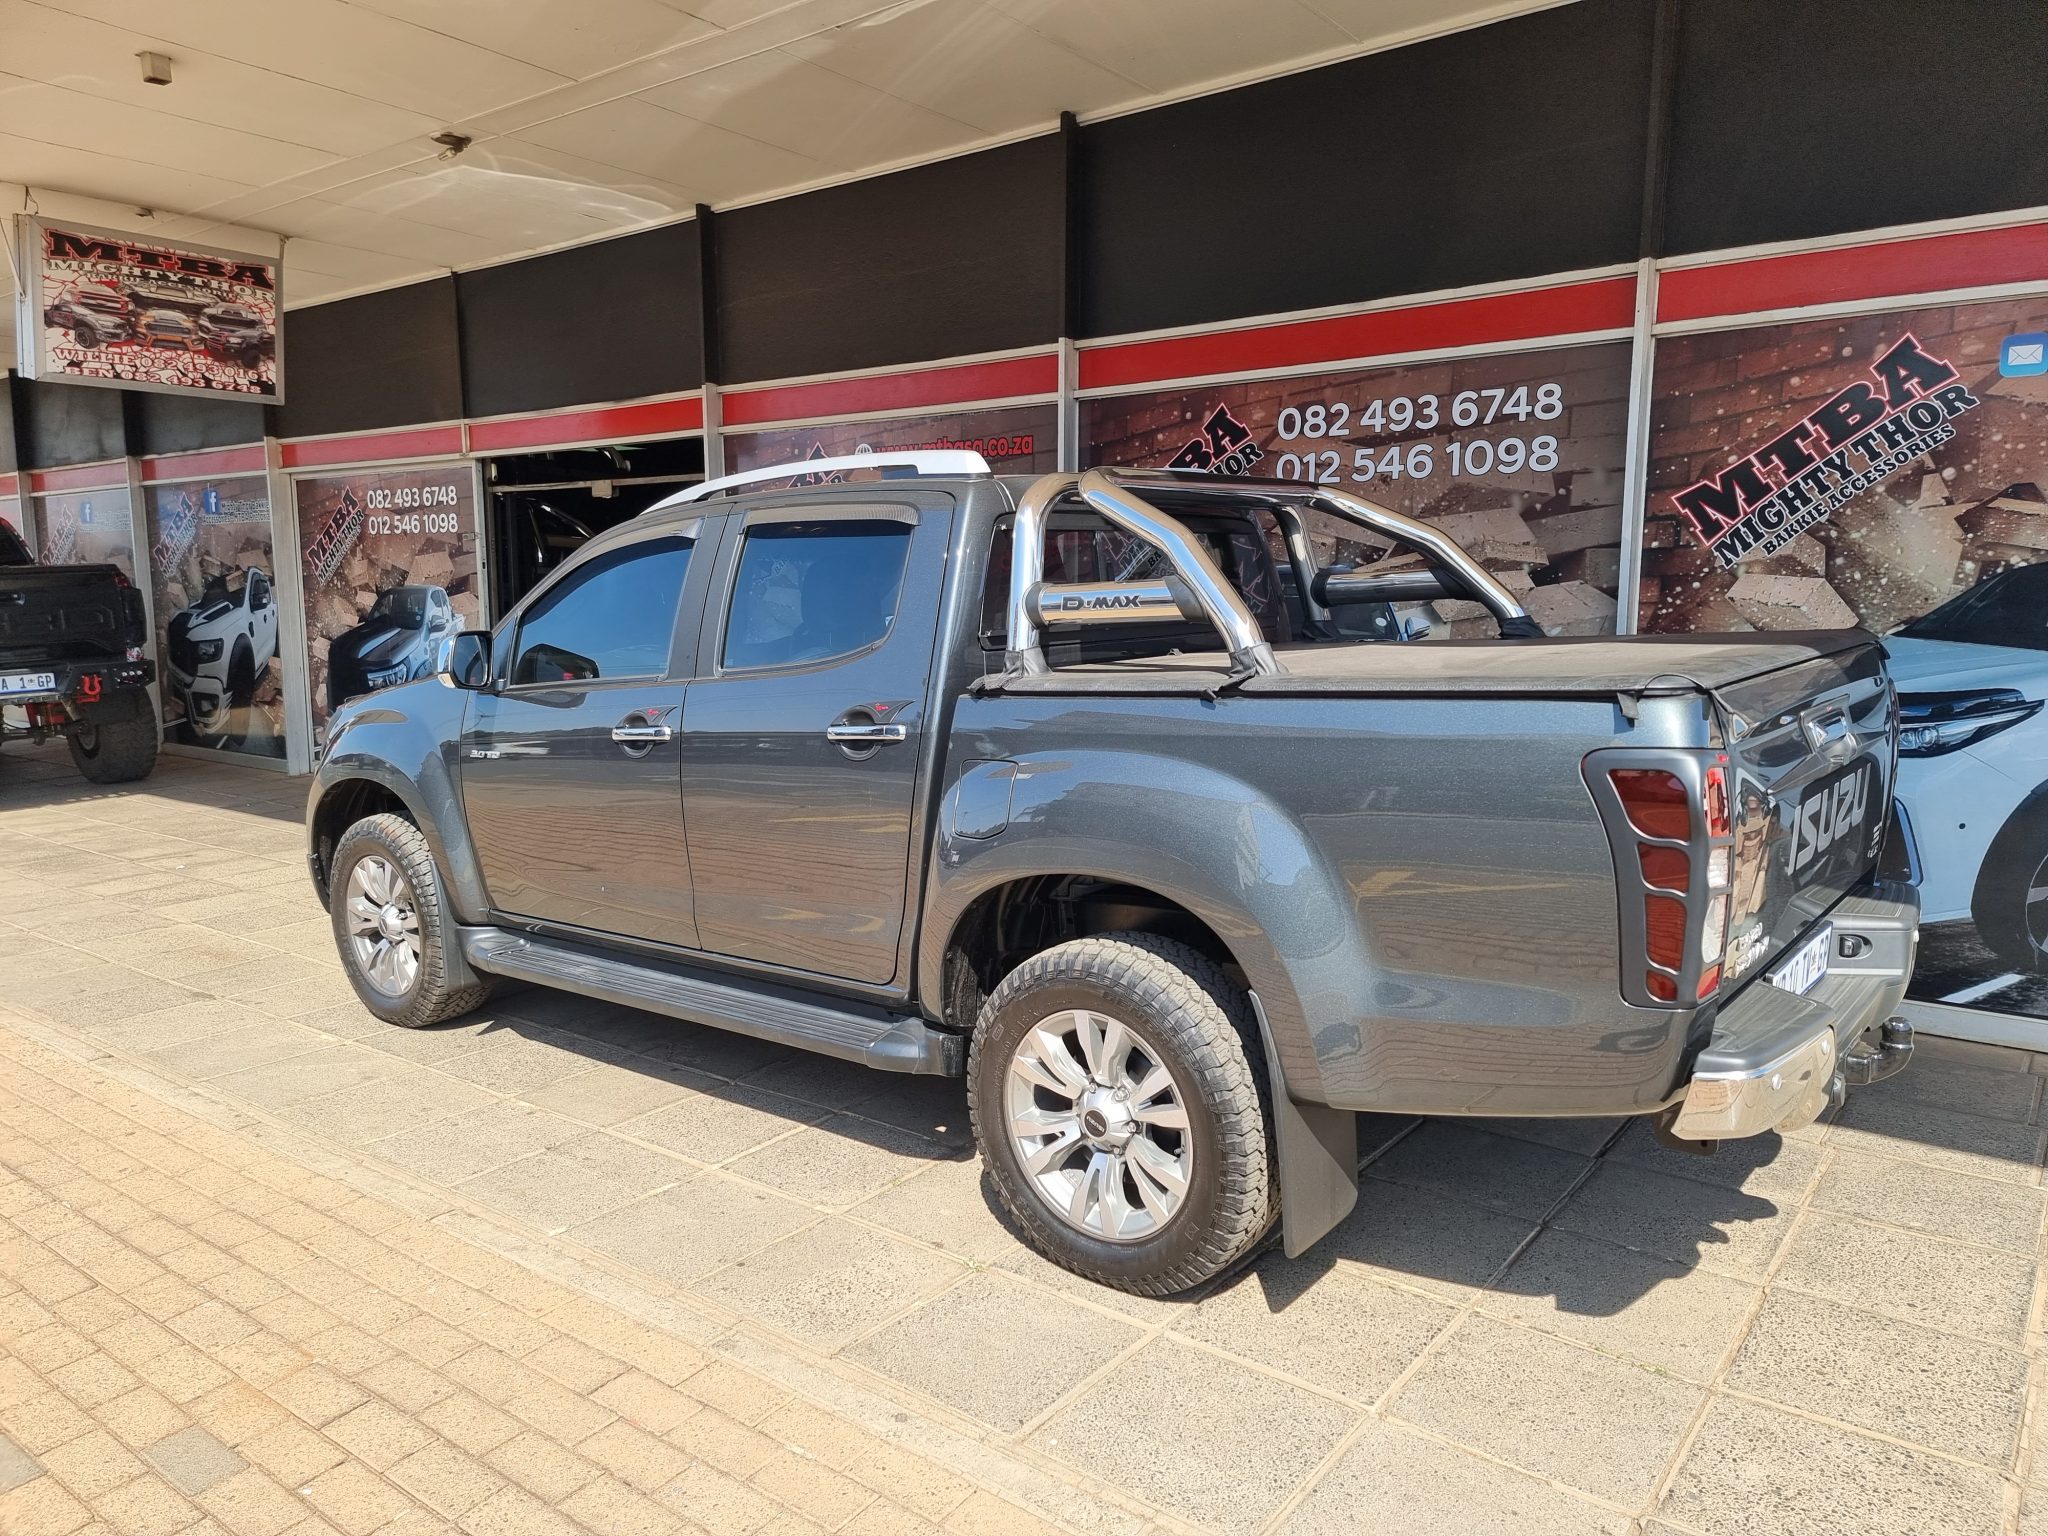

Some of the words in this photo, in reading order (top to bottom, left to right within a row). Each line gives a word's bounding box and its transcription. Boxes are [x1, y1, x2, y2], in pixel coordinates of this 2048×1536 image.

[47, 228, 276, 291] MTBA
[49, 258, 184, 282] MIGHTY
[192, 275, 276, 303] THOR
[53, 347, 136, 367] WILLIE
[140, 356, 178, 371] 082
[184, 361, 220, 376] 493
[224, 366, 269, 383] 0161
[120, 369, 161, 384] 082
[167, 374, 207, 389] 493
[211, 380, 262, 395] 6748
[1164, 402, 1253, 471] BA
[1276, 402, 1350, 441] 082
[1360, 394, 1440, 434] 493
[1451, 382, 1564, 427] 6748
[1671, 332, 1961, 548] MTBA
[1276, 449, 1342, 484] 012
[1351, 443, 1434, 482] 546
[1446, 434, 1560, 477] 1098
[1712, 447, 1858, 570] MIGHTY
[1853, 383, 1980, 474] THOR
[367, 489, 392, 509] 082
[394, 487, 420, 508] 493
[422, 485, 458, 507] 6748
[1761, 503, 1830, 557] BAKKIE
[1827, 423, 1957, 511] ACCESSORIES
[153, 491, 195, 572] MTBA
[180, 511, 199, 544] THOR
[306, 485, 360, 575] MTBA
[316, 537, 345, 585] MIGHTY
[343, 508, 366, 543] THOR
[368, 516, 391, 535] 012
[394, 514, 421, 534] 546
[423, 513, 459, 534] 1098
[1061, 594, 1141, 612] D-MAX
[37, 674, 52, 688] GP
[1787, 762, 1872, 877] ISUZU
